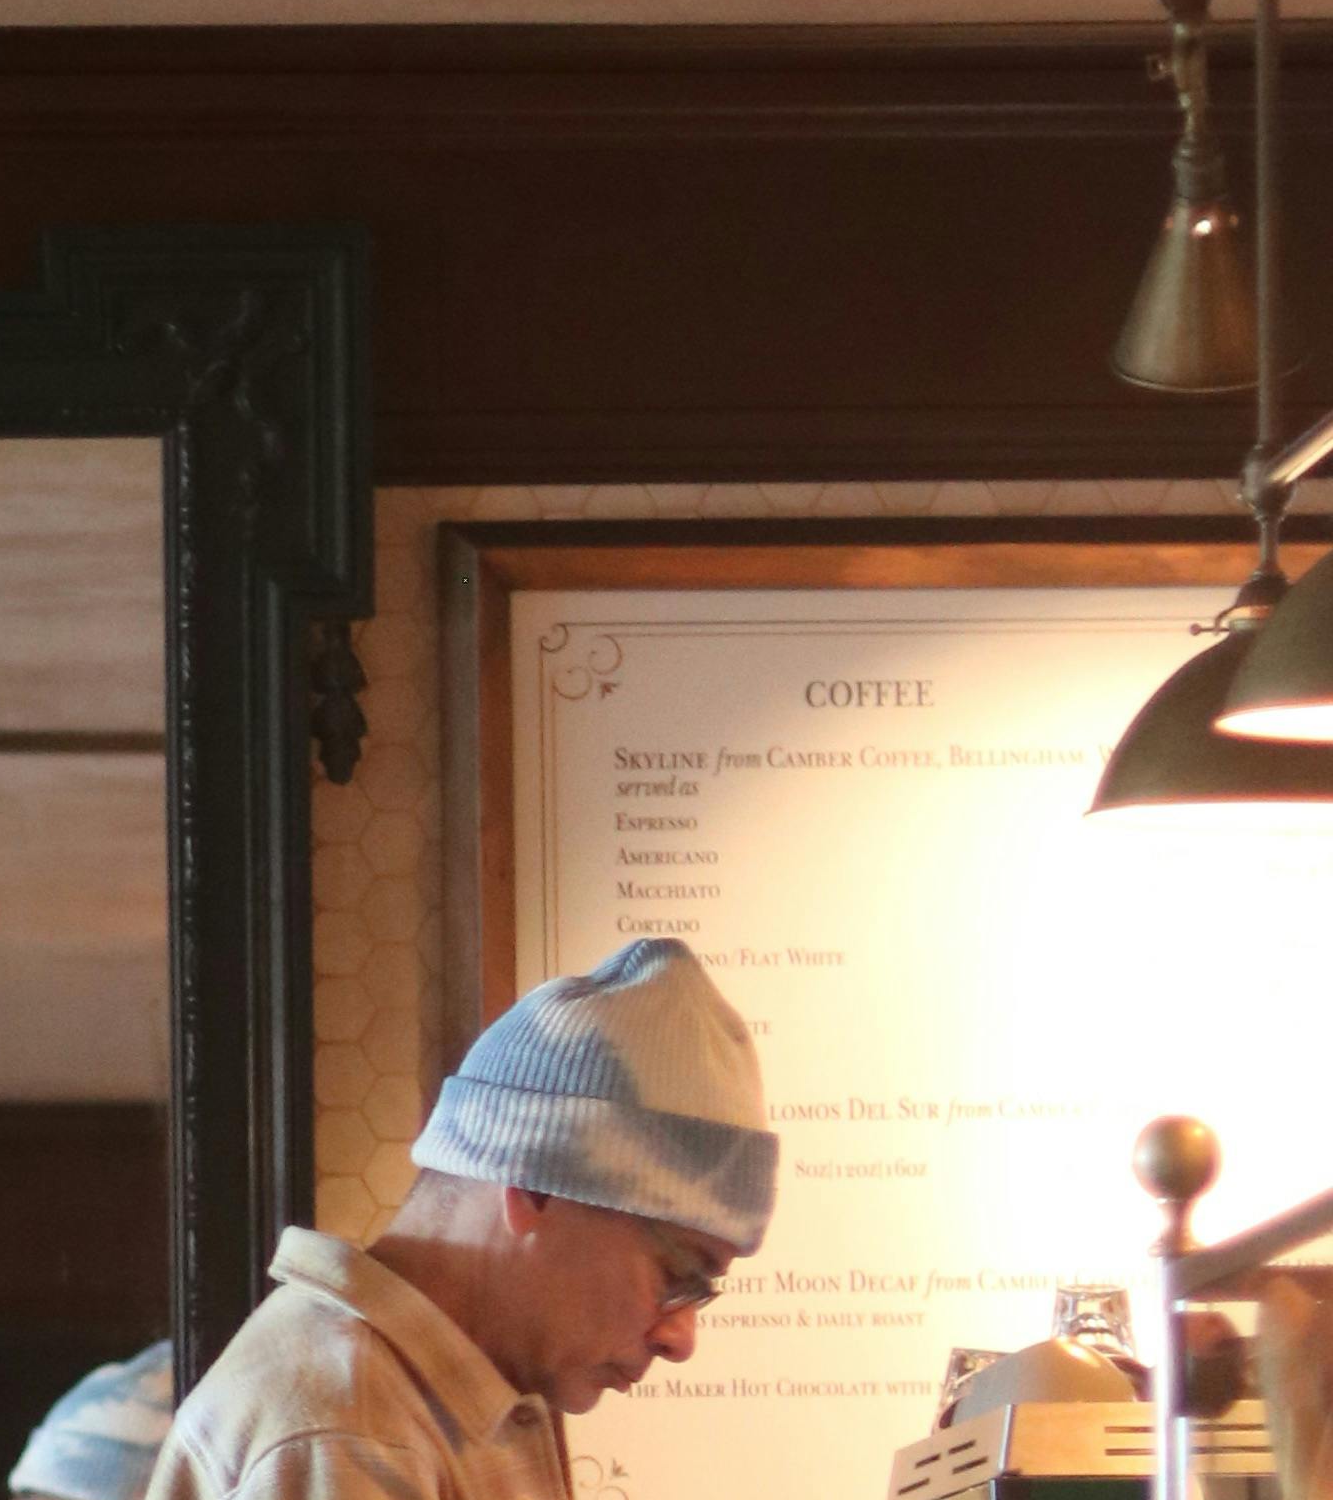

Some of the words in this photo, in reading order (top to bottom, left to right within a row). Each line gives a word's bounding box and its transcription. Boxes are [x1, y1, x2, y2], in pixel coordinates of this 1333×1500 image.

[805, 679, 935, 708] COFFEE
[615, 747, 708, 770] SKYLINE
[714, 746, 761, 777] from
[767, 746, 853, 769] CAMBER
[616, 812, 698, 831] ESPRESSO
[617, 847, 719, 865] AMERICANO
[617, 881, 720, 899] MACCHIATO
[617, 916, 700, 933] CORTADO
[787, 948, 846, 967] WHITE
[769, 1104, 840, 1121] LOMOS
[848, 1097, 890, 1121] DEL
[898, 1097, 939, 1121] SUR
[944, 1097, 993, 1126] from
[775, 1271, 841, 1293] MOON
[849, 1270, 918, 1292] DECAF
[923, 1269, 971, 1298] from
[712, 1313, 790, 1328] ESPRESSO
[797, 1310, 812, 1327] &
[817, 1312, 864, 1328] DAILY
[871, 1312, 926, 1327] ROAST
[665, 1379, 726, 1398] MAKER
[732, 1379, 770, 1397] HOT
[776, 1377, 882, 1396] CHOCOLATE
[886, 1380, 932, 1396] WITH
